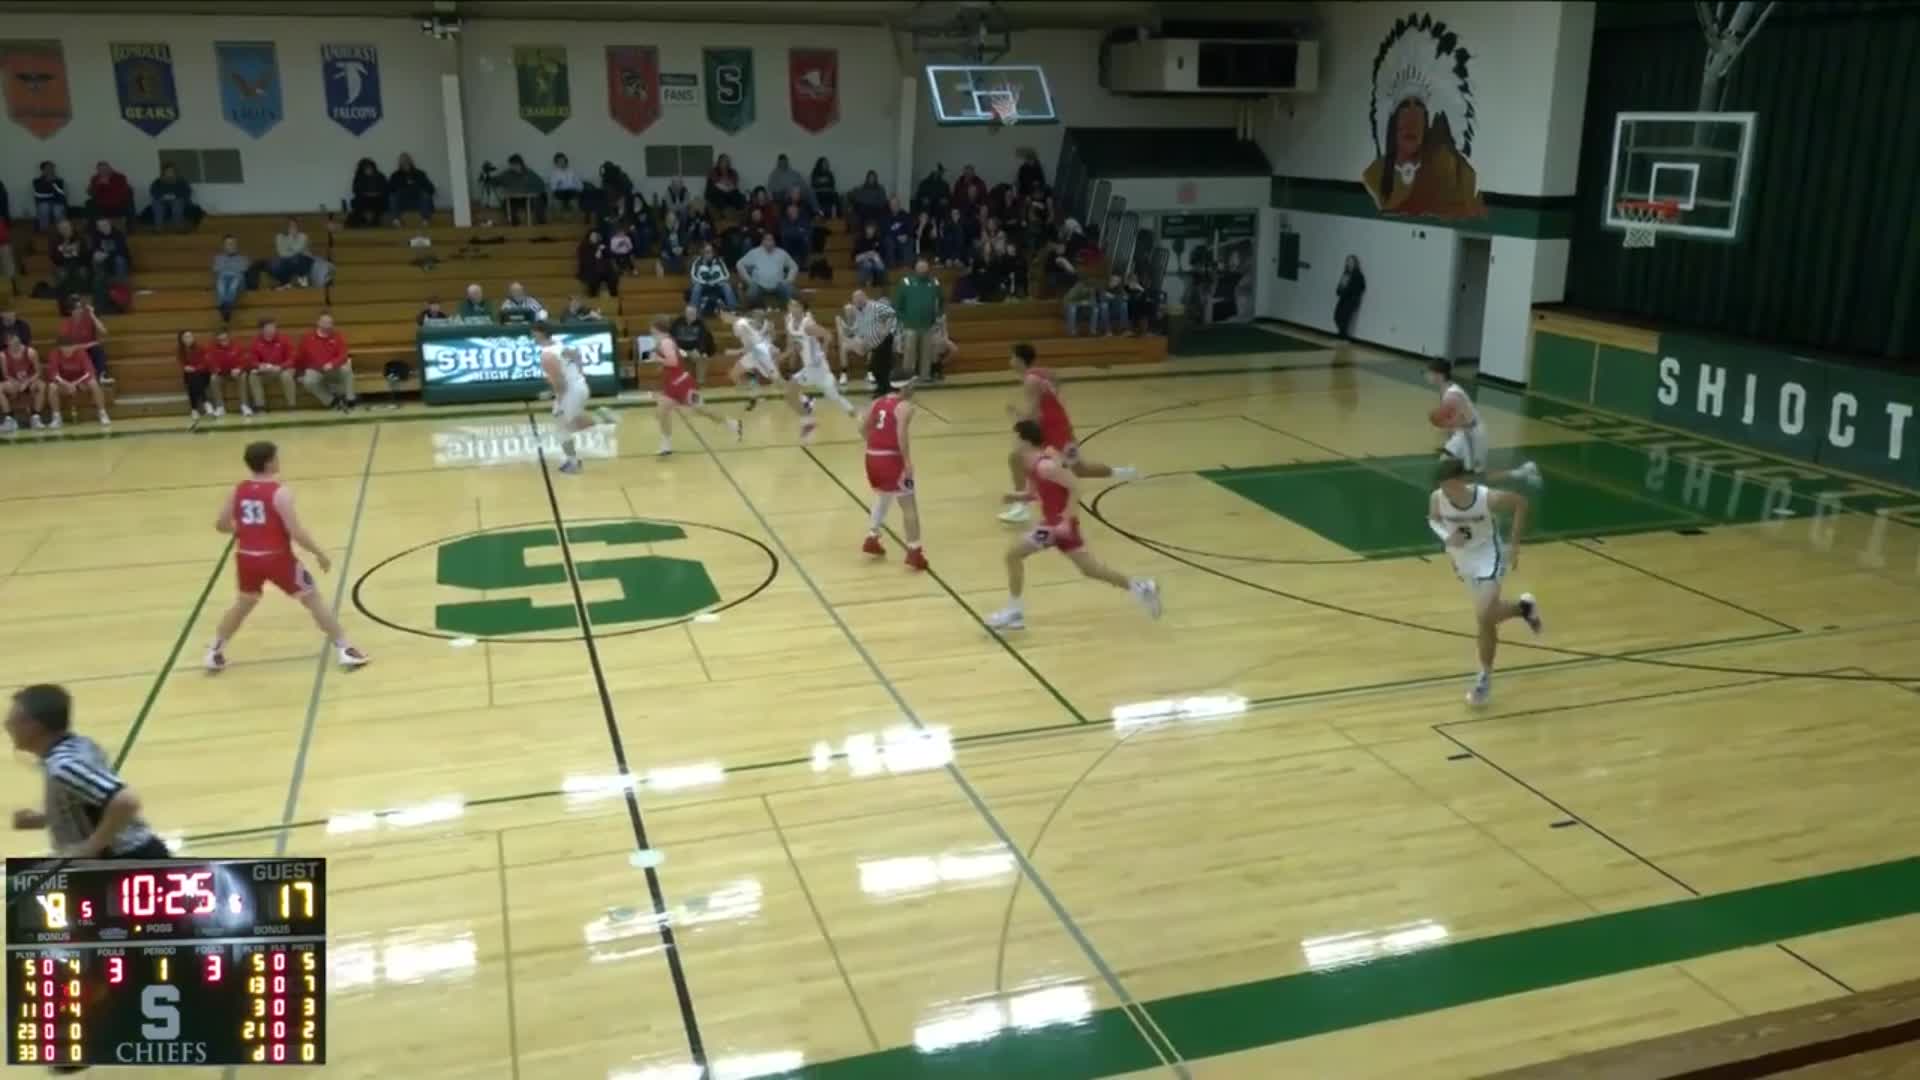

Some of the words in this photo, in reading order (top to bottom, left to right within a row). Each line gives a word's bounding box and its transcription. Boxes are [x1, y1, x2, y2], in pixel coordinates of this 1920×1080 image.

[663, 88, 695, 101] FANS
[716, 65, 743, 105] S
[332, 106, 377, 119] FALCONS
[437, 343, 602, 372] SHIOCN
[876, 410, 887, 430] 3
[1657, 356, 1913, 460] SHIOCT
[240, 499, 266, 524] 33
[435, 521, 722, 637] S
